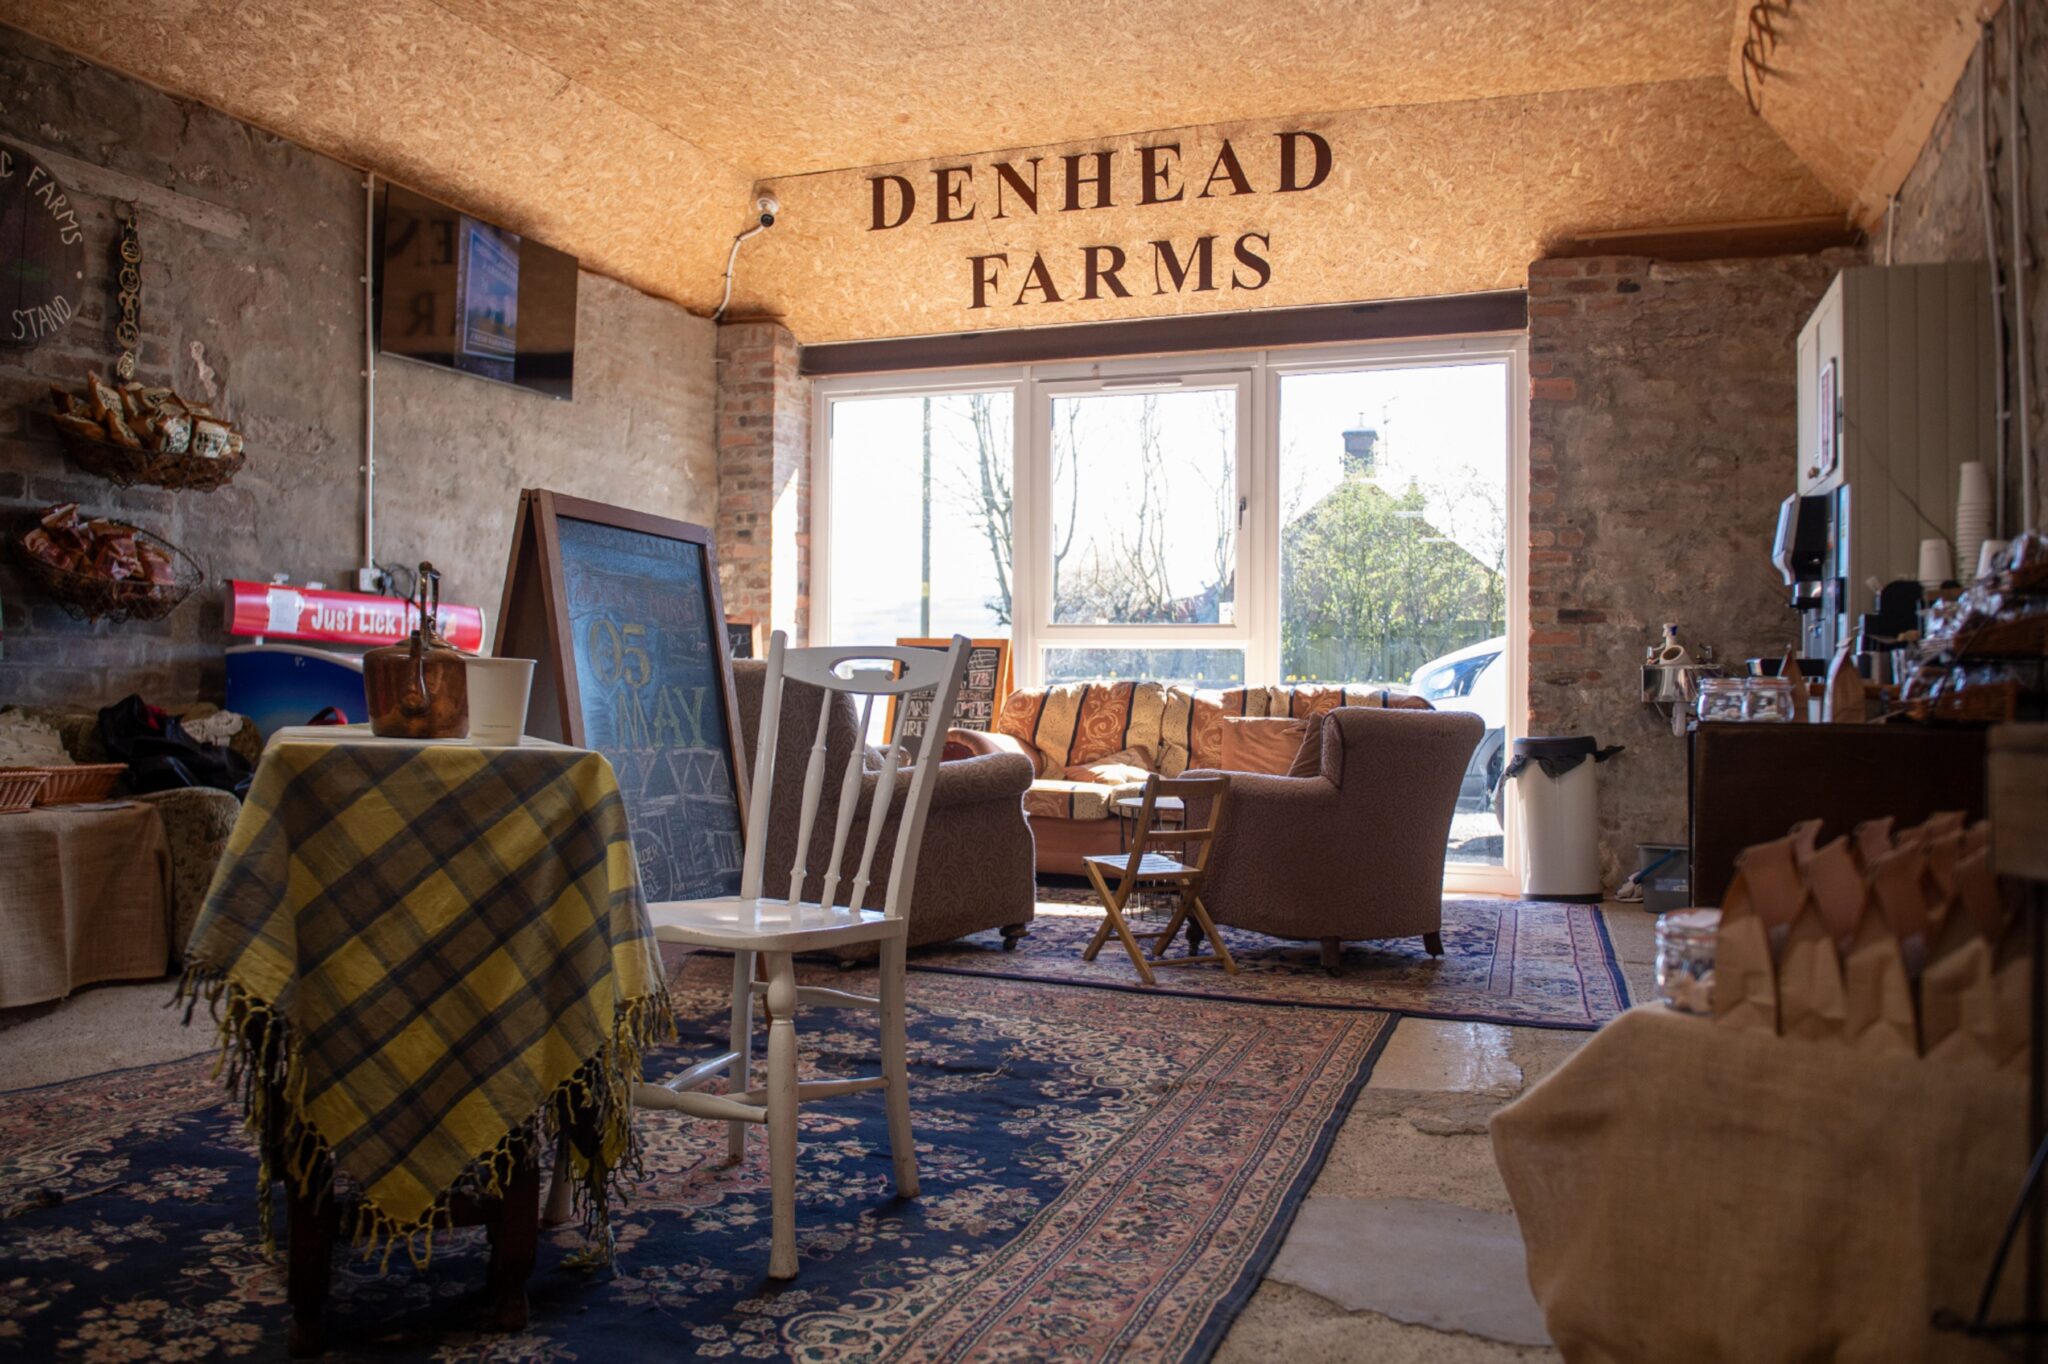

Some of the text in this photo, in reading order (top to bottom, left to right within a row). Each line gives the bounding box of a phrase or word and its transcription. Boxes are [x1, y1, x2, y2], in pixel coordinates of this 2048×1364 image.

[27, 166, 82, 244] FARMS
[865, 130, 1334, 232] DENHEAD
[966, 231, 1272, 310] FARMS
[11, 295, 72, 340] STAND
[311, 602, 354, 632] Just
[589, 619, 650, 689] 05
[618, 685, 707, 750] MAY
